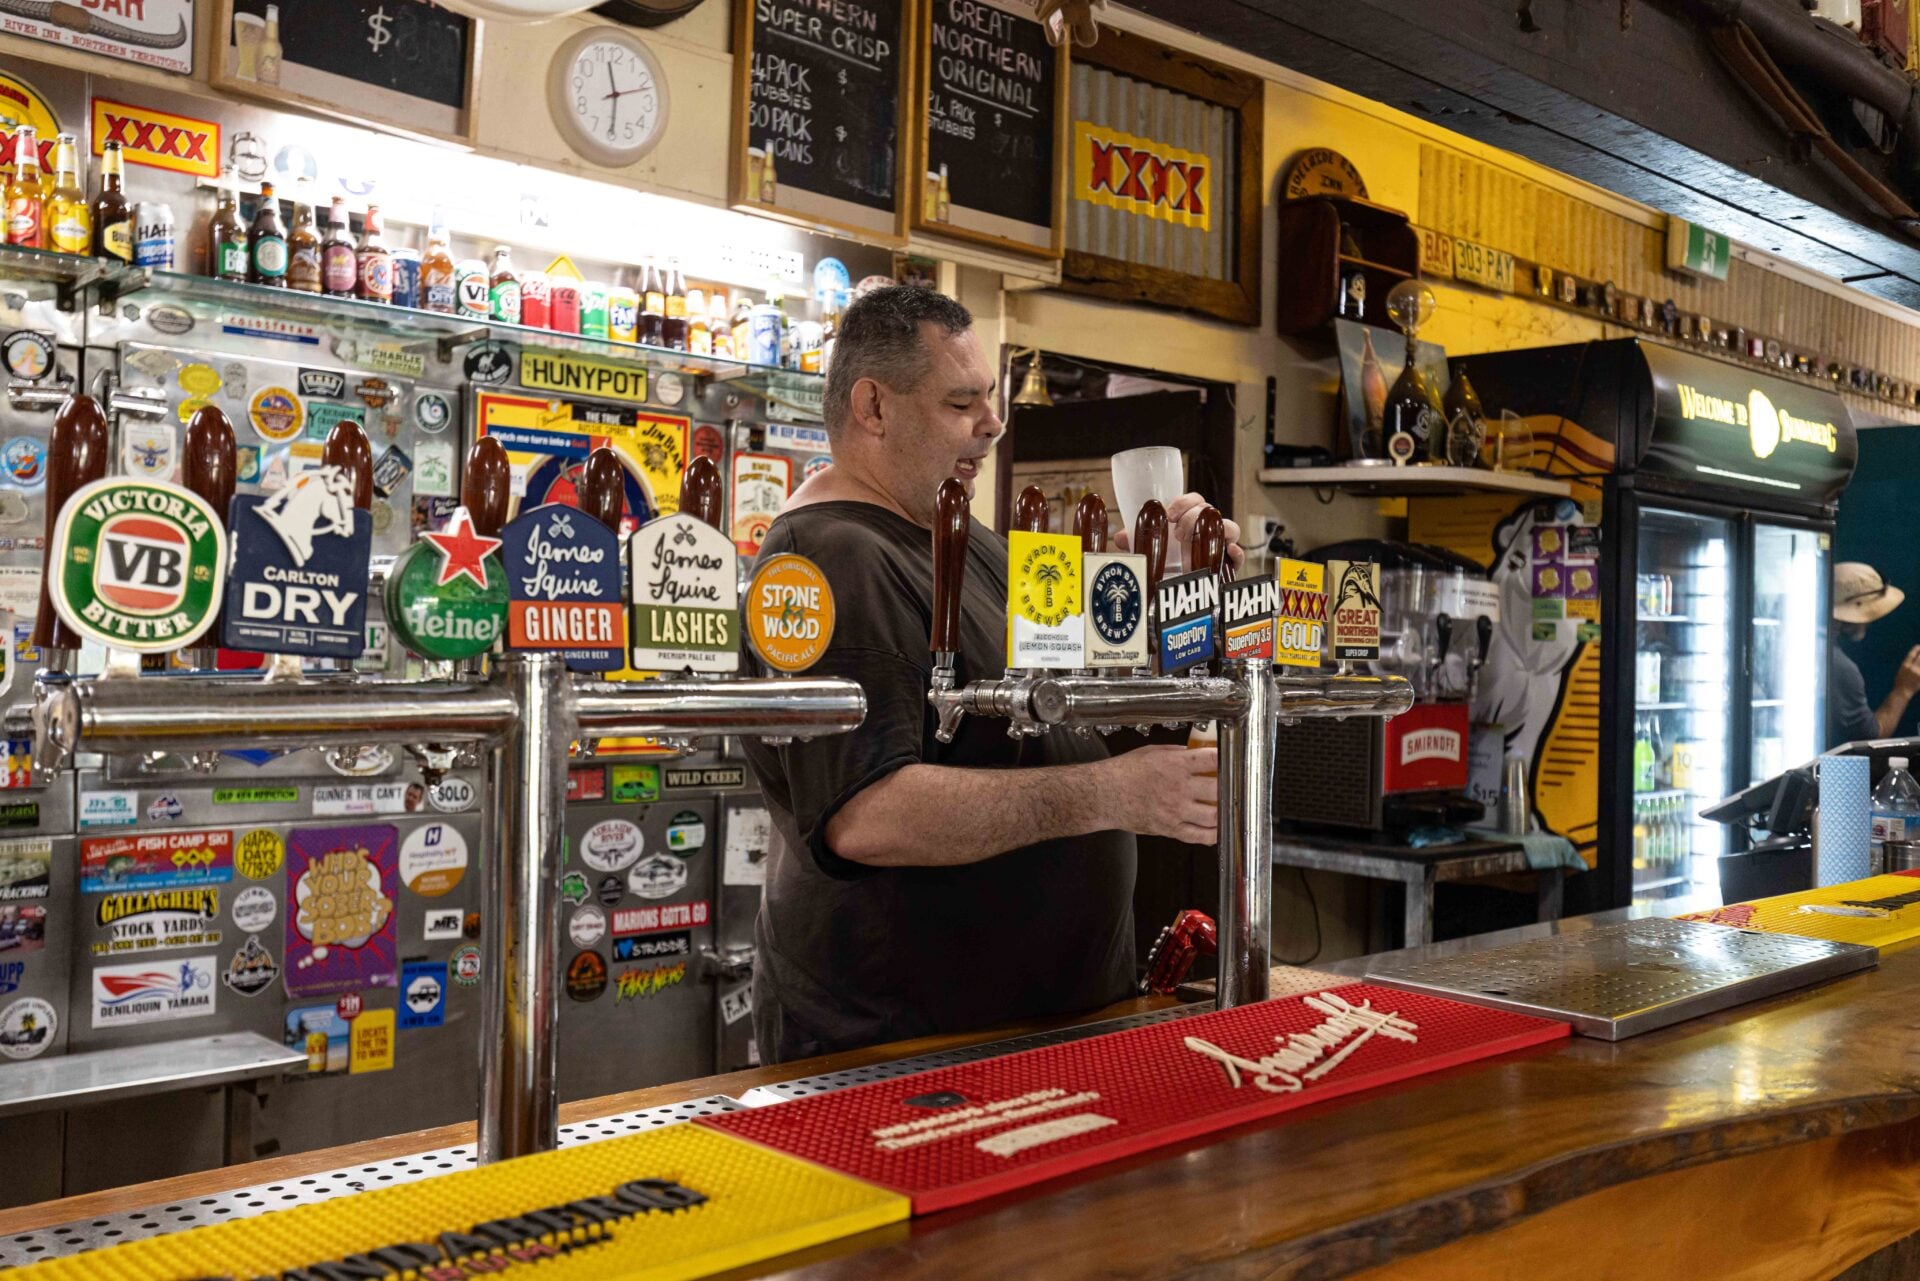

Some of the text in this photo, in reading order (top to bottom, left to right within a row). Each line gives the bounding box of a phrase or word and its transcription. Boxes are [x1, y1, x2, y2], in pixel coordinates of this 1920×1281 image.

[366, 5, 392, 52] $
[756, 1, 890, 63] SUPER CRISP
[949, 0, 1015, 43] GREAT
[4, 19, 39, 36] RIVER
[42, 29, 61, 41] INN
[72, 35, 127, 57] NORTHERN
[932, 24, 1041, 83] NORTHERN
[938, 55, 1039, 113] ORIGINAL
[772, 108, 813, 143] PACK
[950, 99, 977, 126] PACK
[104, 113, 208, 162] XXXX
[774, 139, 813, 165] CANS
[1089, 134, 1205, 216] XXXX
[371, 349, 421, 364] CHARLIE
[532, 358, 644, 396] HUNYPOT
[642, 423, 663, 443] JIM
[83, 490, 210, 542] VICTORIA
[524, 523, 605, 565] James
[651, 532, 723, 570] James
[106, 538, 182, 589] VB
[767, 563, 816, 581] THE ORIGINAL
[1023, 545, 1076, 578] BYRON BAY
[263, 565, 340, 588] CARLTON
[521, 561, 603, 601] Squire
[648, 566, 720, 605] Squire
[1097, 568, 1138, 594] BYRON BAY
[242, 581, 359, 626] DRY
[762, 584, 820, 611] STONE
[1021, 594, 1074, 628] BREWERY
[1159, 573, 1219, 623] HAHN
[1224, 580, 1280, 623] HAHN
[1280, 587, 1330, 623] XXXX
[81, 598, 193, 638] BITTER
[525, 606, 612, 642] GINGER
[651, 609, 728, 646] LASHES
[763, 614, 820, 640] WOOD
[1096, 614, 1138, 639] BREWERY
[1337, 608, 1378, 626] GREAT
[1167, 625, 1207, 652] SuperDry
[1227, 626, 1271, 652] SuperDry 3.5
[1281, 621, 1321, 652] GOLD
[1337, 625, 1378, 637] NORTHERN
[564, 650, 609, 660] GINGER BEER
[658, 651, 686, 661] PREMIUM
[766, 643, 817, 663] PACIFIC ALE
[1050, 643, 1082, 652] SQUASH
[1175, 646, 1201, 660] LOW CARB
[1407, 734, 1456, 755] SMIRNOFF
[668, 769, 742, 786] WILD CREEK
[316, 785, 403, 801] GUNNER THE CAN'T
[438, 785, 469, 802] SOLO
[137, 837, 167, 851] FISH
[169, 833, 205, 848] CAMP
[208, 832, 228, 847] SKI
[243, 831, 278, 847] HAPPY
[592, 821, 633, 838] ADELAIDE
[601, 831, 625, 843] RIVER
[244, 849, 277, 862] DAYS
[304, 868, 373, 897] YOUR
[101, 888, 218, 925] GALLAGHER'S
[301, 888, 378, 924] SOBER
[614, 910, 659, 933] MARIONS
[660, 905, 691, 927] GOTTA
[692, 903, 707, 922] GO
[112, 917, 205, 938] STOCK YARDS
[0, 961, 24, 983] UPP
[100, 995, 209, 1018] DENILIQUIN YAMAHA
[357, 1026, 388, 1039] LOCATE
[357, 1036, 388, 1048] THE TIN
[356, 1050, 367, 1060] TO
